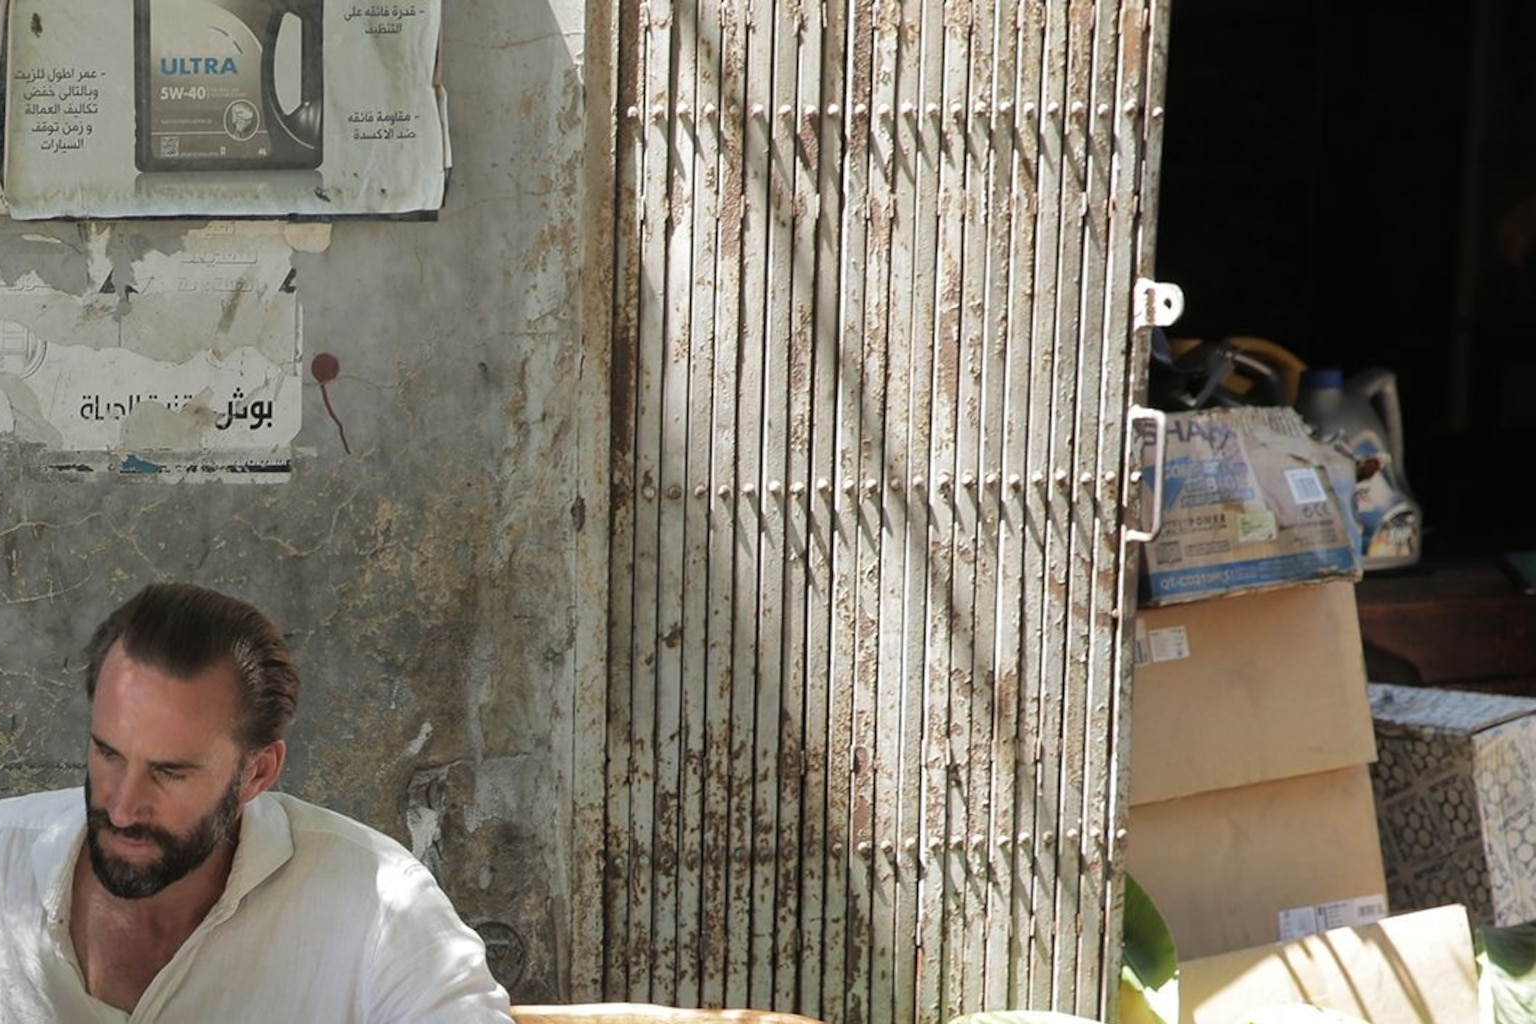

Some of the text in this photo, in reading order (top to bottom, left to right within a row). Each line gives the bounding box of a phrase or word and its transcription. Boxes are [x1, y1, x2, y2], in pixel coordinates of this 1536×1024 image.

[392, 5, 416, 20] قدرة
[364, 23, 402, 37] التنظيف
[160, 57, 238, 75] ULTRA
[14, 68, 45, 83] للزيت
[78, 69, 97, 82] عمر
[23, 86, 55, 100] خفض
[160, 86, 206, 100] 5W-40
[24, 103, 98, 117] تكاليف العمالة
[376, 110, 411, 125] مقاومة
[31, 121, 60, 136] توقف
[62, 121, 84, 135] زمن
[397, 128, 416, 140] ضد
[40, 138, 84, 153] السيارات
[215, 387, 273, 430] بوش
